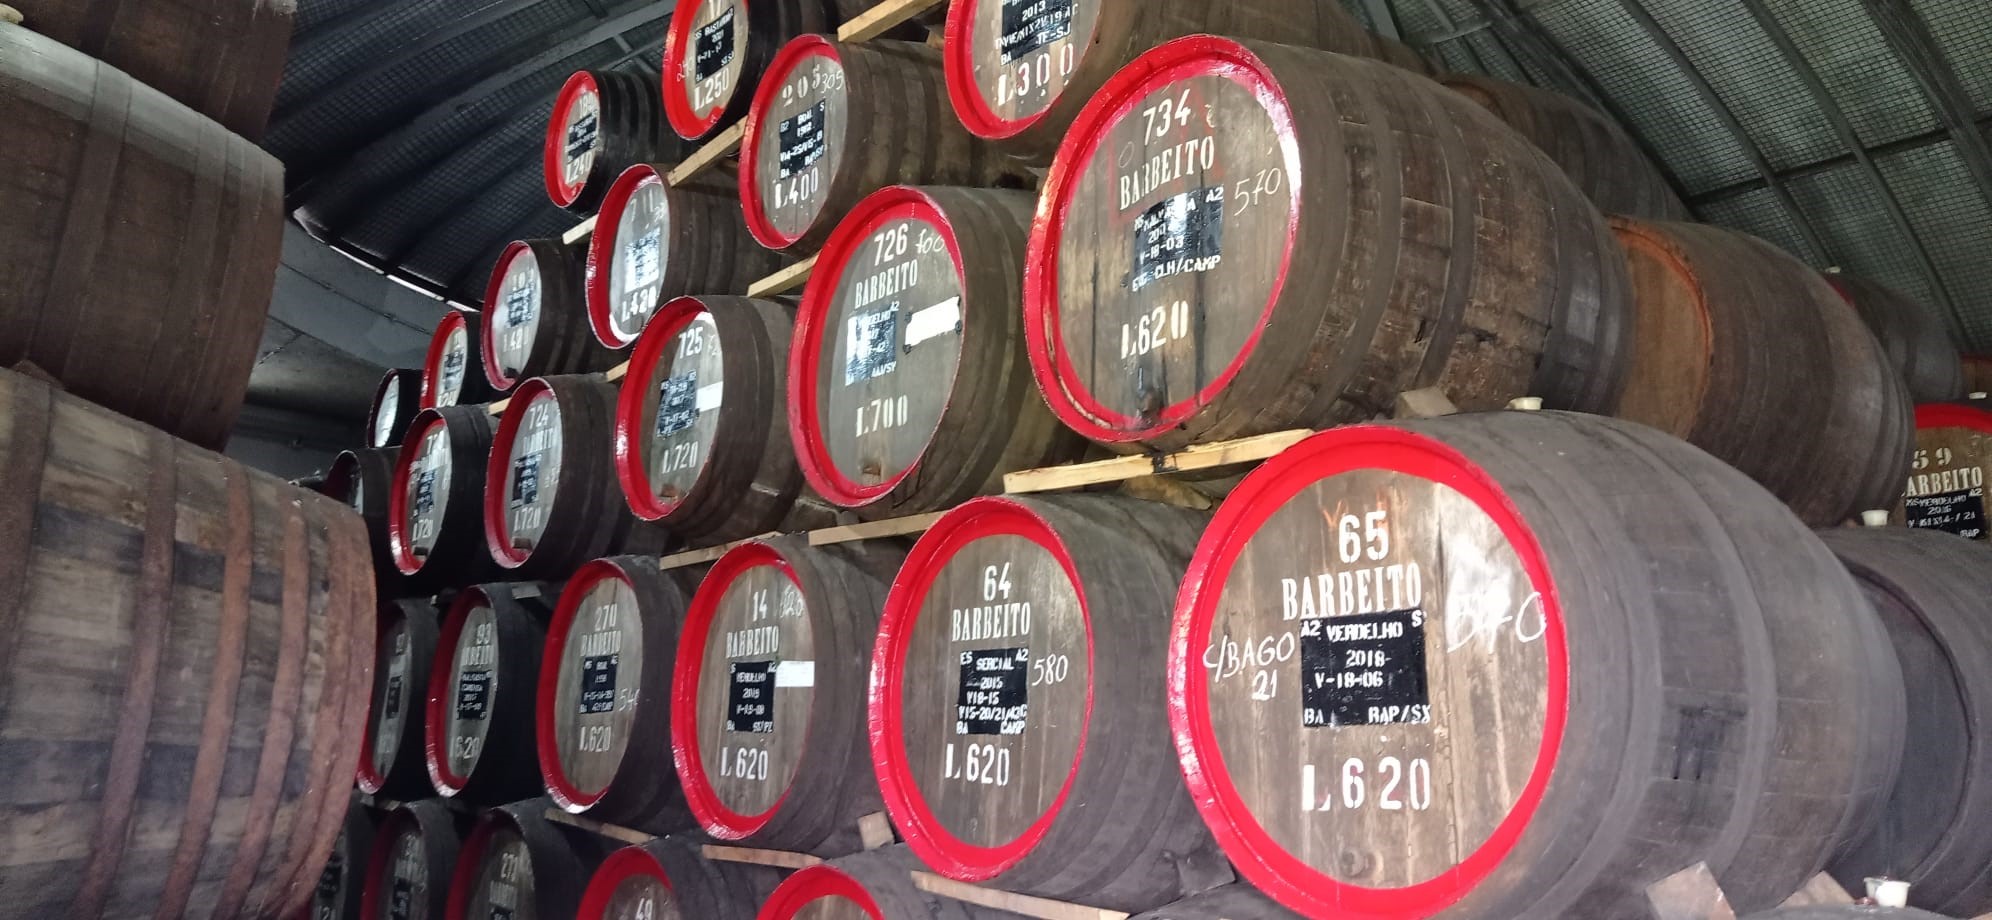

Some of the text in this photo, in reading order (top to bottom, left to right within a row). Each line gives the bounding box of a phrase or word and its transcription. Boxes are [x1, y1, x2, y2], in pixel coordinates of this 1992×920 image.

[1021, 1, 1046, 21] 2013
[998, 43, 1074, 106] L300
[1001, 51, 1011, 66] BA
[694, 67, 730, 112] L250
[782, 64, 821, 107] 205
[1143, 88, 1192, 146] 734
[775, 167, 819, 209] L400
[1120, 135, 1214, 210] BARBEITO
[1205, 186, 1224, 203] A2
[874, 223, 908, 266] 726
[855, 259, 918, 309] BARBEITO
[678, 326, 704, 360] 725
[1121, 300, 1189, 360] L620
[856, 394, 909, 437] L700
[662, 441, 699, 474] L720
[1901, 466, 1983, 497] ARBEITO
[513, 506, 542, 533] L720
[1338, 511, 1390, 563] 65
[983, 562, 1012, 602] 64
[1282, 562, 1422, 621] BARBEITO
[594, 603, 618, 632] 270
[753, 589, 768, 622] 14
[952, 602, 1031, 642] BARBEITO
[727, 626, 779, 658] BARBEITO
[1300, 620, 1321, 639] A2
[1326, 621, 1403, 643] VERDELHO
[960, 651, 973, 665] ES
[976, 648, 1029, 671] SERCIAL A2
[1032, 654, 1069, 687] 580
[1202, 632, 1296, 682] C/BAGO
[1251, 670, 1279, 701] 21
[1315, 671, 1384, 689] V-18-06
[956, 721, 968, 735] BA
[1304, 708, 1324, 724] BA
[579, 726, 612, 751] L620
[721, 747, 768, 781] L620
[945, 743, 1010, 786] L620
[1302, 756, 1431, 812] L620
